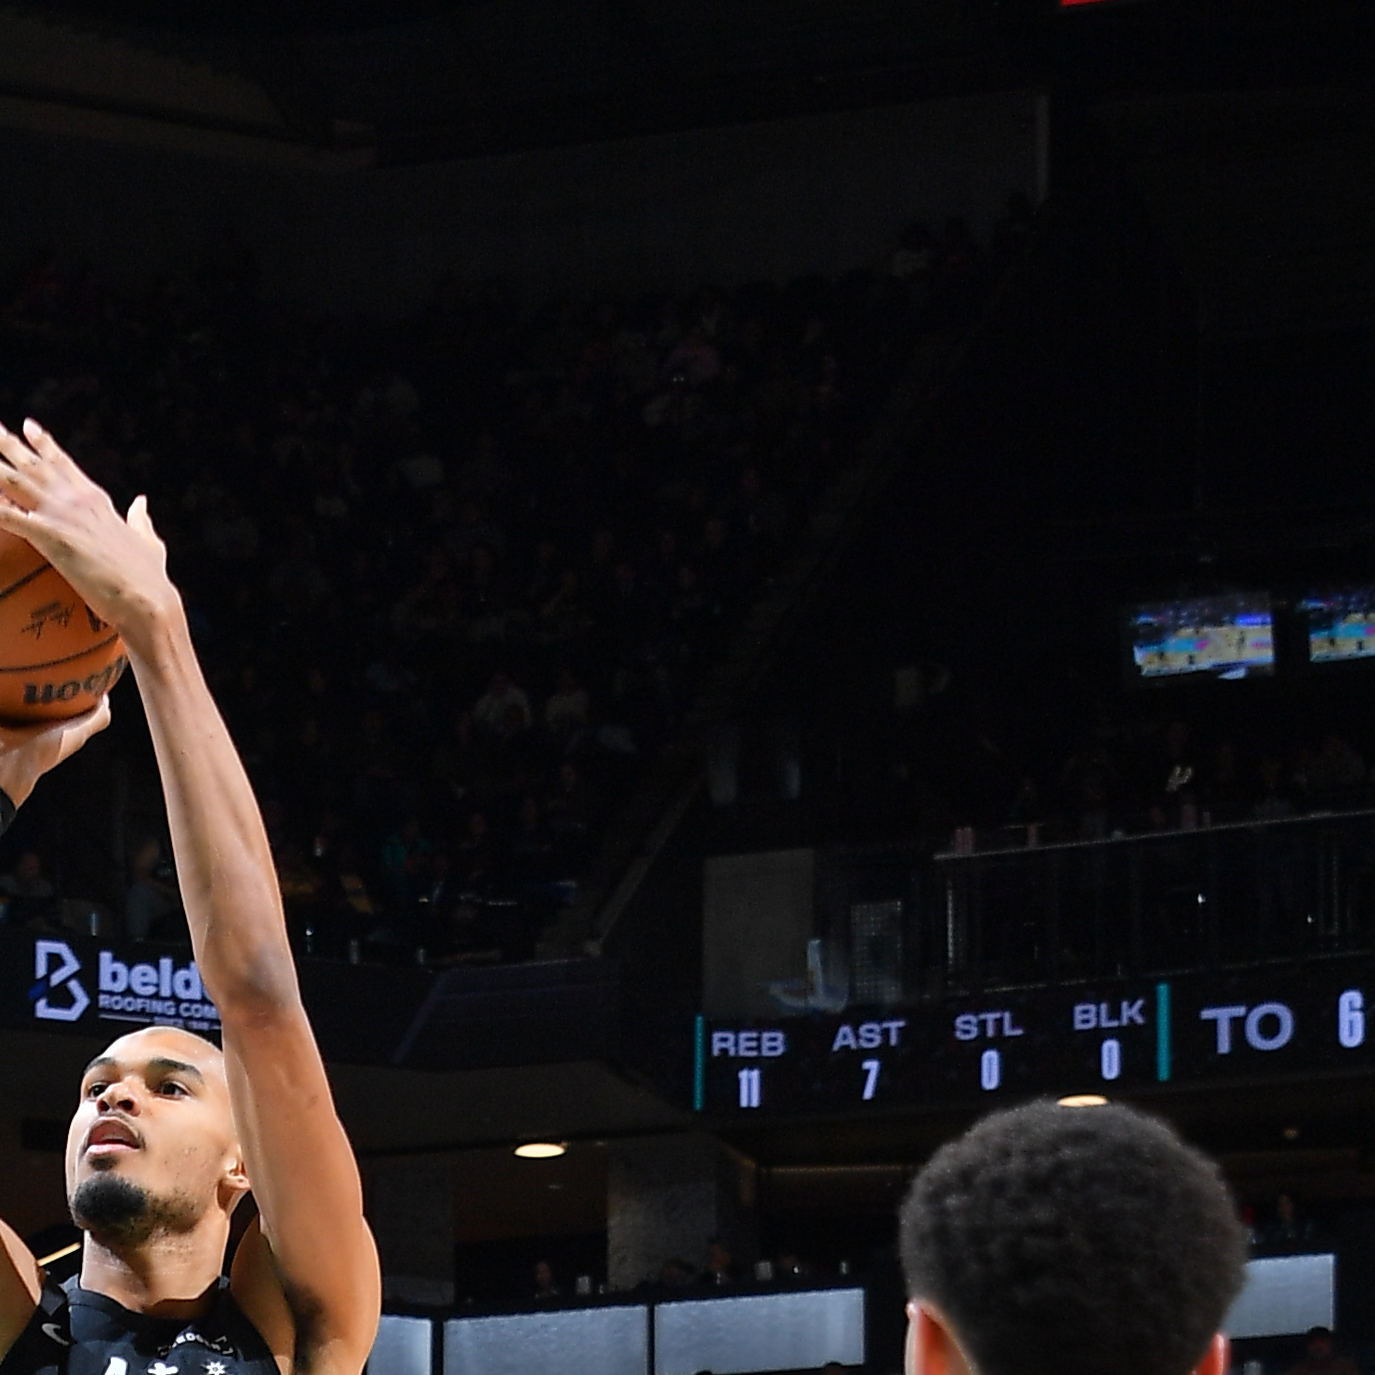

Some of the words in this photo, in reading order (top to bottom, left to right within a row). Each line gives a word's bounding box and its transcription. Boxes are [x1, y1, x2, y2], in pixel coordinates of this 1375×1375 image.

[98, 950, 213, 1001] beld
[98, 993, 176, 1015] ROOFING
[178, 1002, 220, 1021] COM
[711, 1030, 787, 1057] REB
[831, 1019, 906, 1051] AST
[953, 1010, 1024, 1041] STL
[1073, 998, 1146, 1031] BLK
[1199, 1001, 1295, 1055] TO
[1337, 989, 1366, 1049] 6
[737, 1068, 761, 1109] 11
[861, 1058, 881, 1101] 7
[980, 1048, 1001, 1091] 0
[1100, 1038, 1122, 1081] 0
